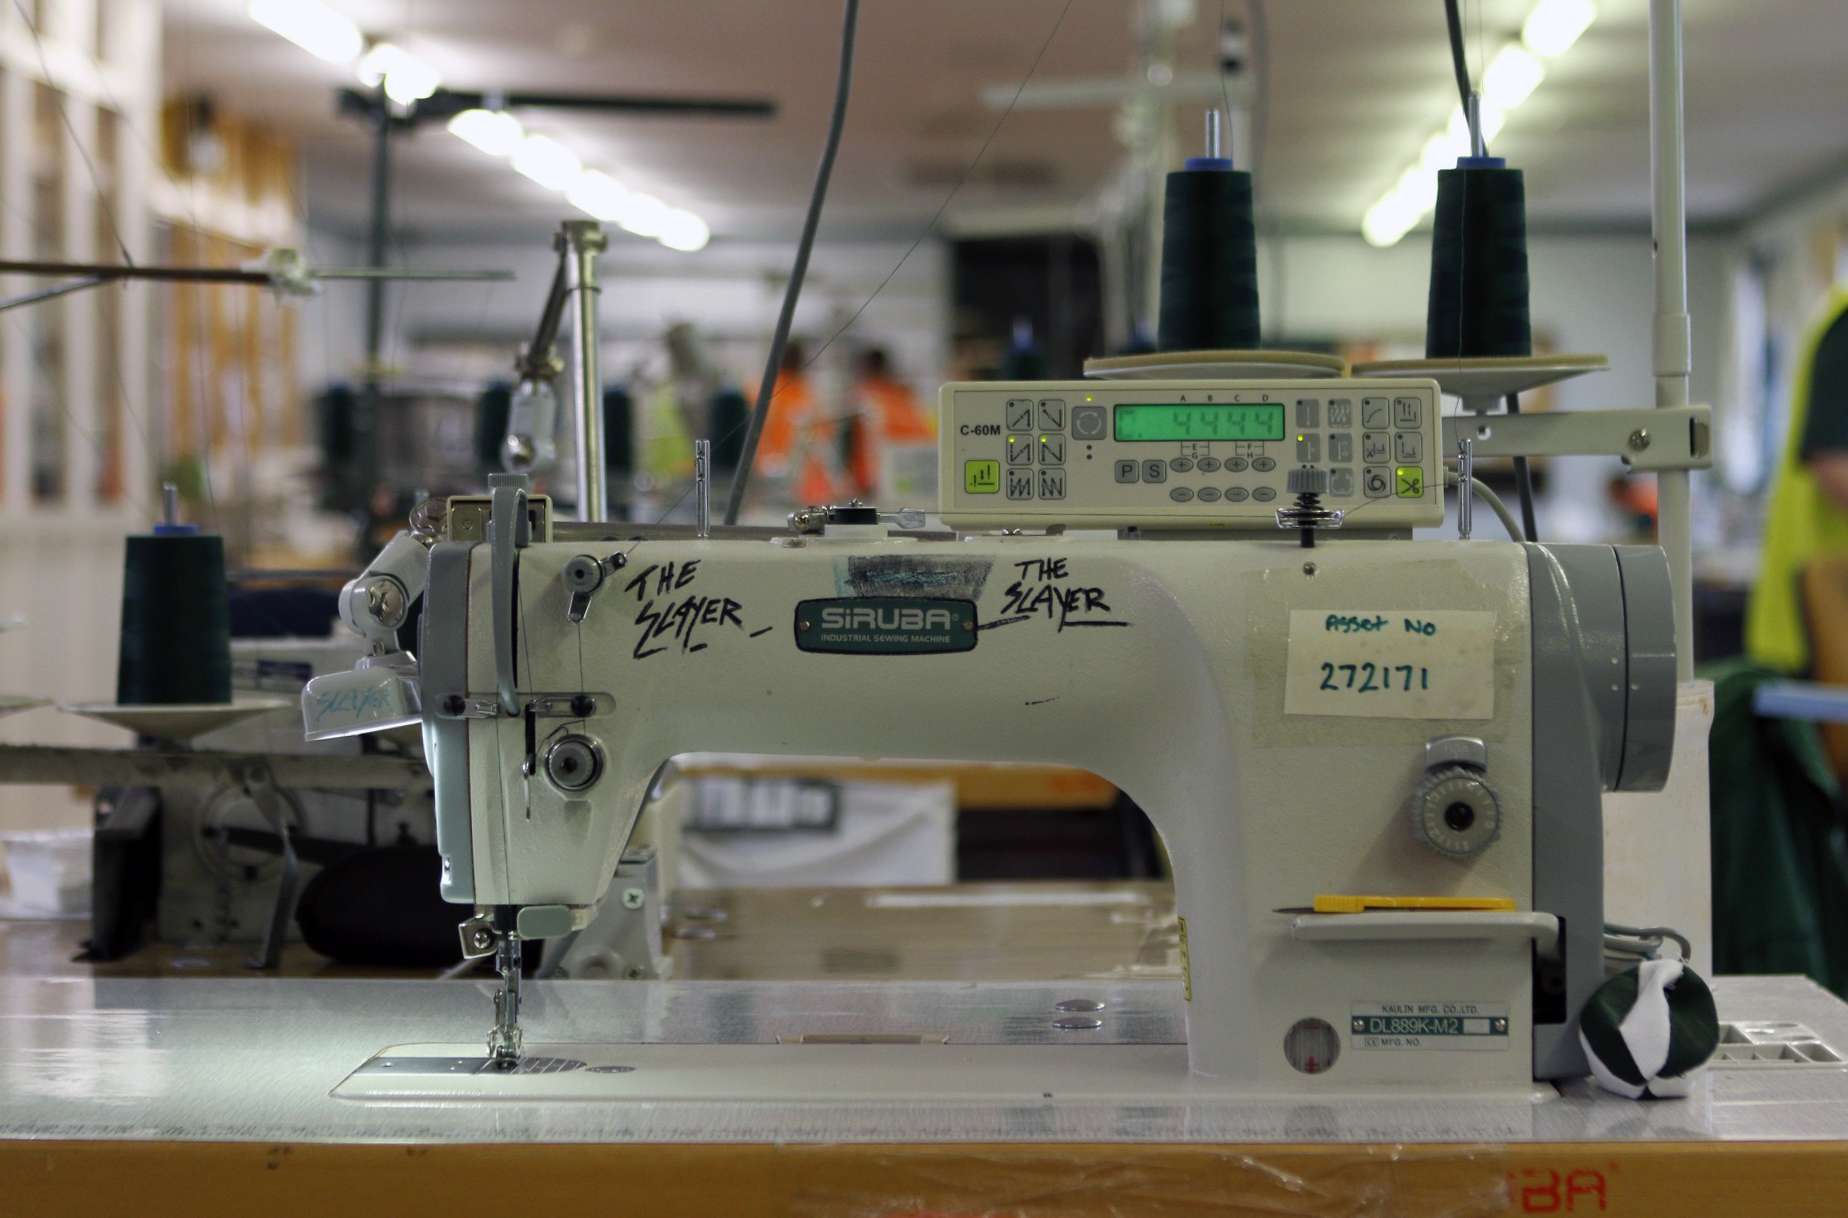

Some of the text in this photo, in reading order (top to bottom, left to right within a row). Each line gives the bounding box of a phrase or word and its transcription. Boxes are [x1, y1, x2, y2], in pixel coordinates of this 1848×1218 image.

[1179, 394, 1269, 402] A B C D
[959, 424, 1001, 436] C-60M
[1121, 464, 1161, 479] P S
[1013, 556, 1070, 582] THE
[624, 559, 702, 602] THE
[1000, 580, 1112, 634] SLAYER
[632, 594, 744, 660] SLAYER
[820, 633, 950, 644] INDUSTRIAL SEWING MACHINE
[1319, 661, 1429, 694] 272171
[1382, 1005, 1415, 1014] KAULIN
[1369, 1017, 1459, 1034] DL889K-M2
